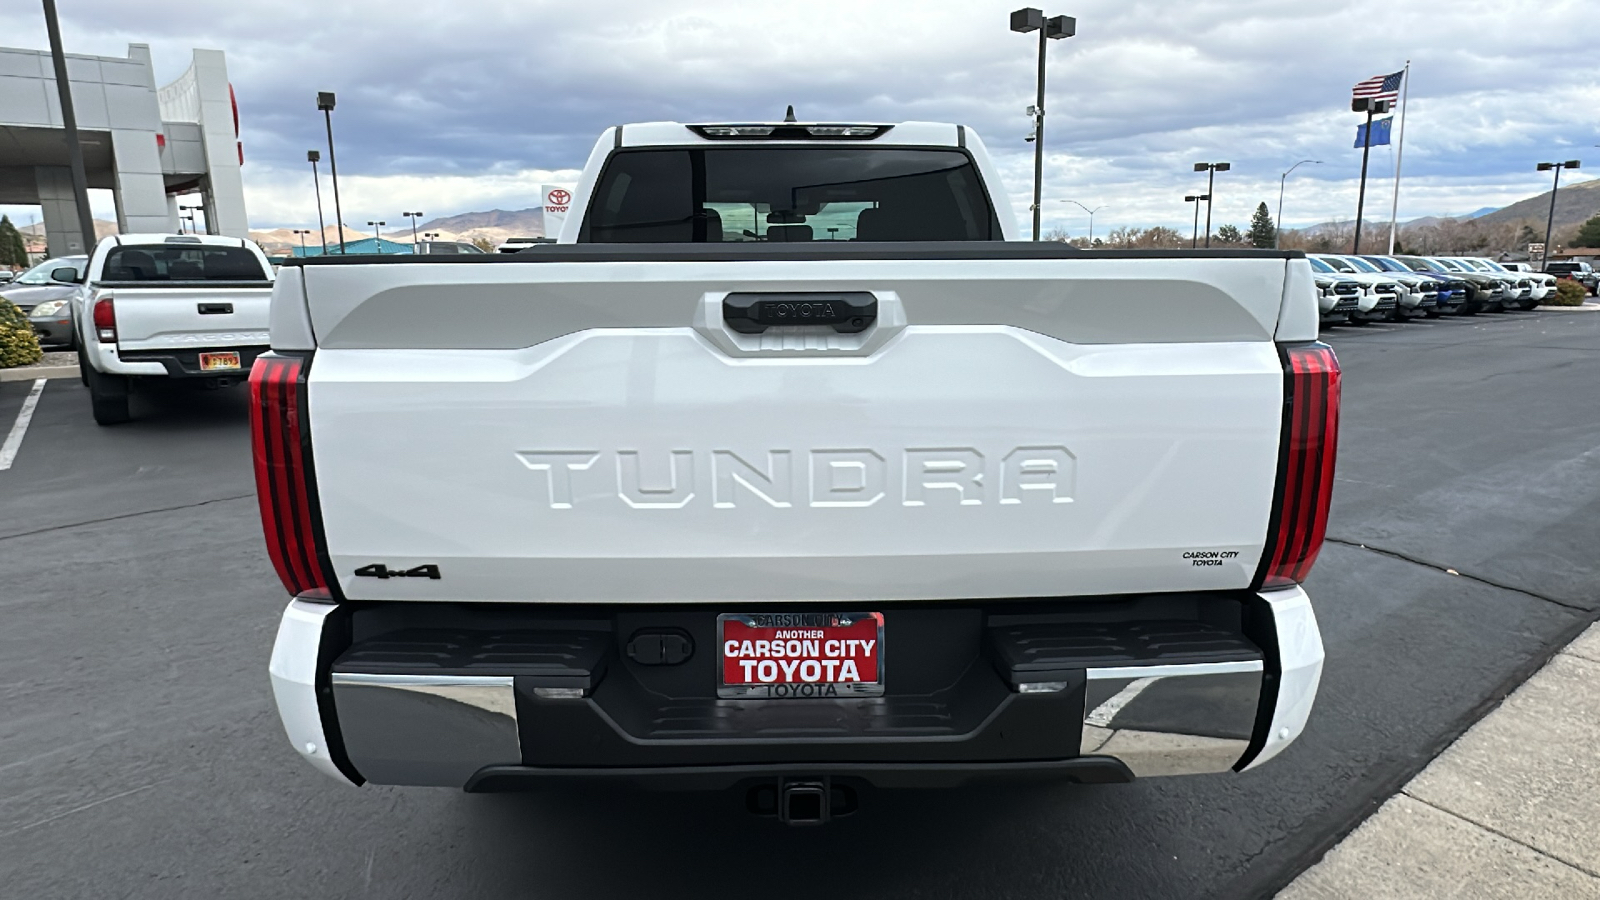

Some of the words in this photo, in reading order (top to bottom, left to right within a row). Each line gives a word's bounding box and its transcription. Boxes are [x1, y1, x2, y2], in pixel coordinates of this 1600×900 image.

[765, 303, 835, 318] TOYOTA
[514, 446, 1077, 509] TUNDRA
[1182, 551, 1219, 559] CARSON
[1220, 551, 1239, 559] CITY
[757, 614, 809, 626] CARSON
[813, 614, 843, 626] CITY
[775, 630, 824, 639] ANOTHER
[724, 640, 820, 658] CARSON
[824, 639, 876, 658] CITY
[739, 659, 861, 682] TOYOTA
[766, 684, 838, 697] TOYOTA
